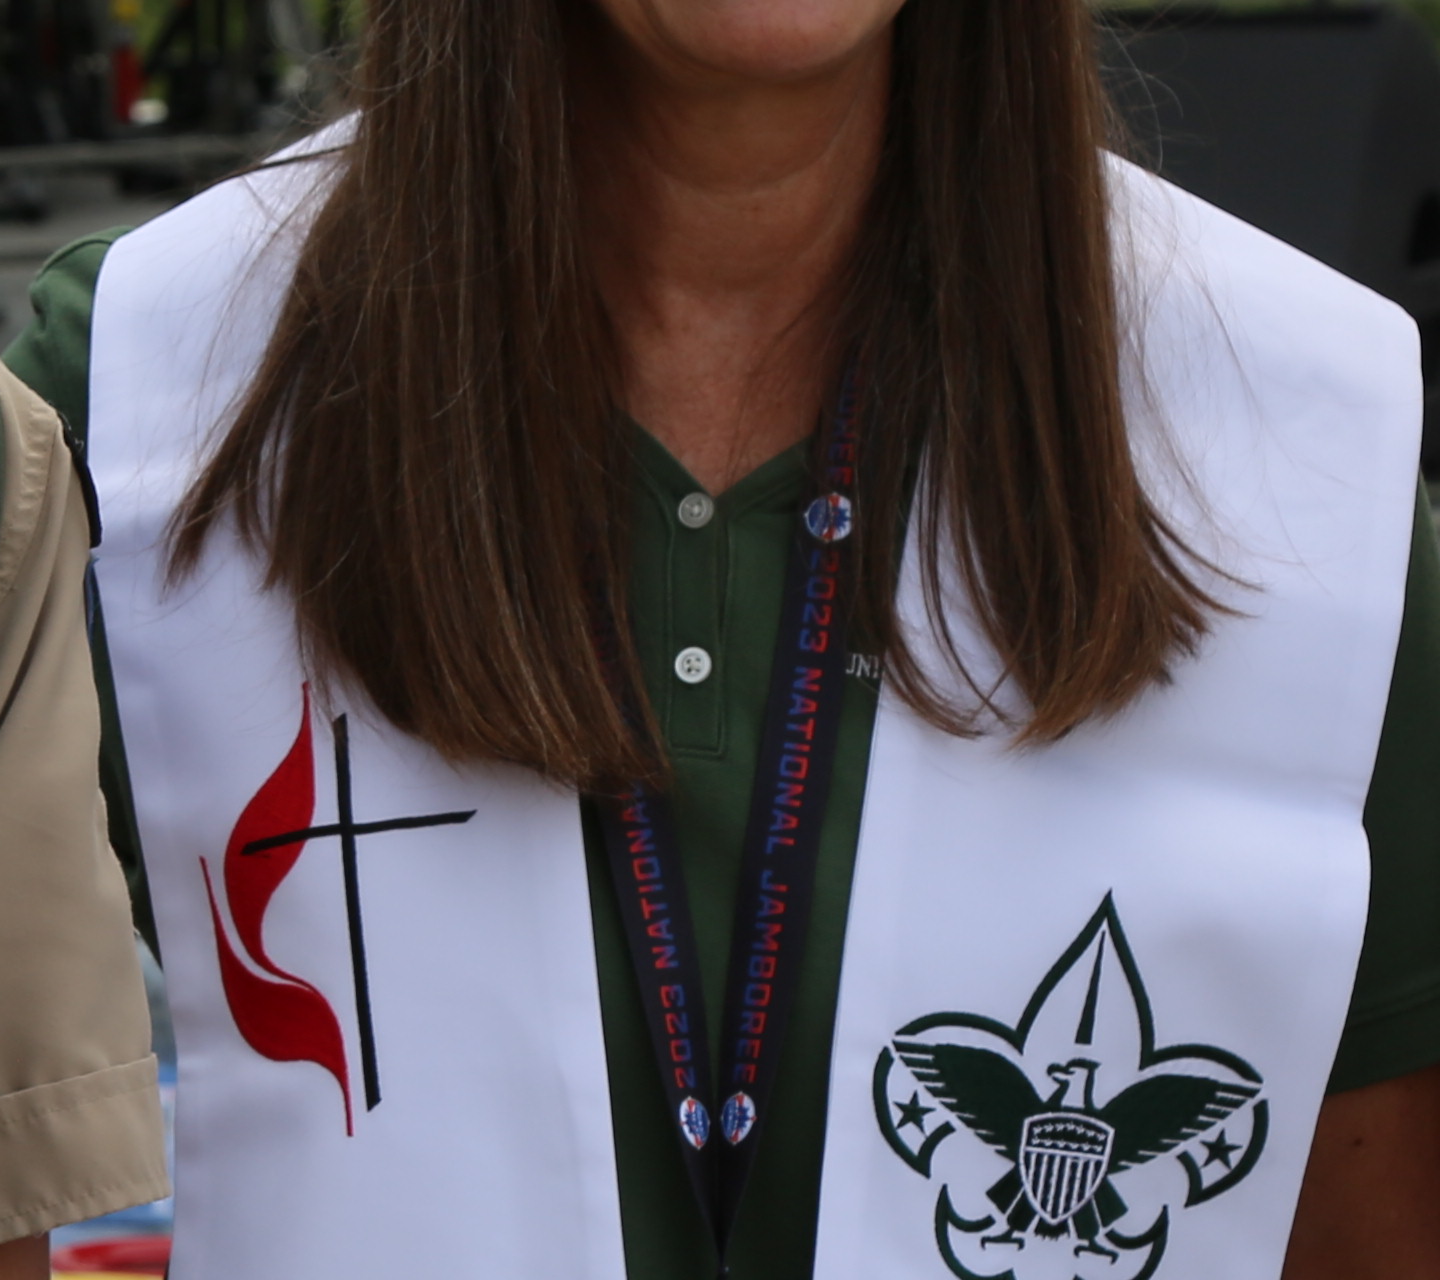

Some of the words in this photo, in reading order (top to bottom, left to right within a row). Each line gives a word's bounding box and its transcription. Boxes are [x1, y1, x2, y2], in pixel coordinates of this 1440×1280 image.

[764, 664, 824, 856] NATIONAL
[660, 981, 696, 1090] 2023
[732, 867, 788, 1085] JAMBOREE
